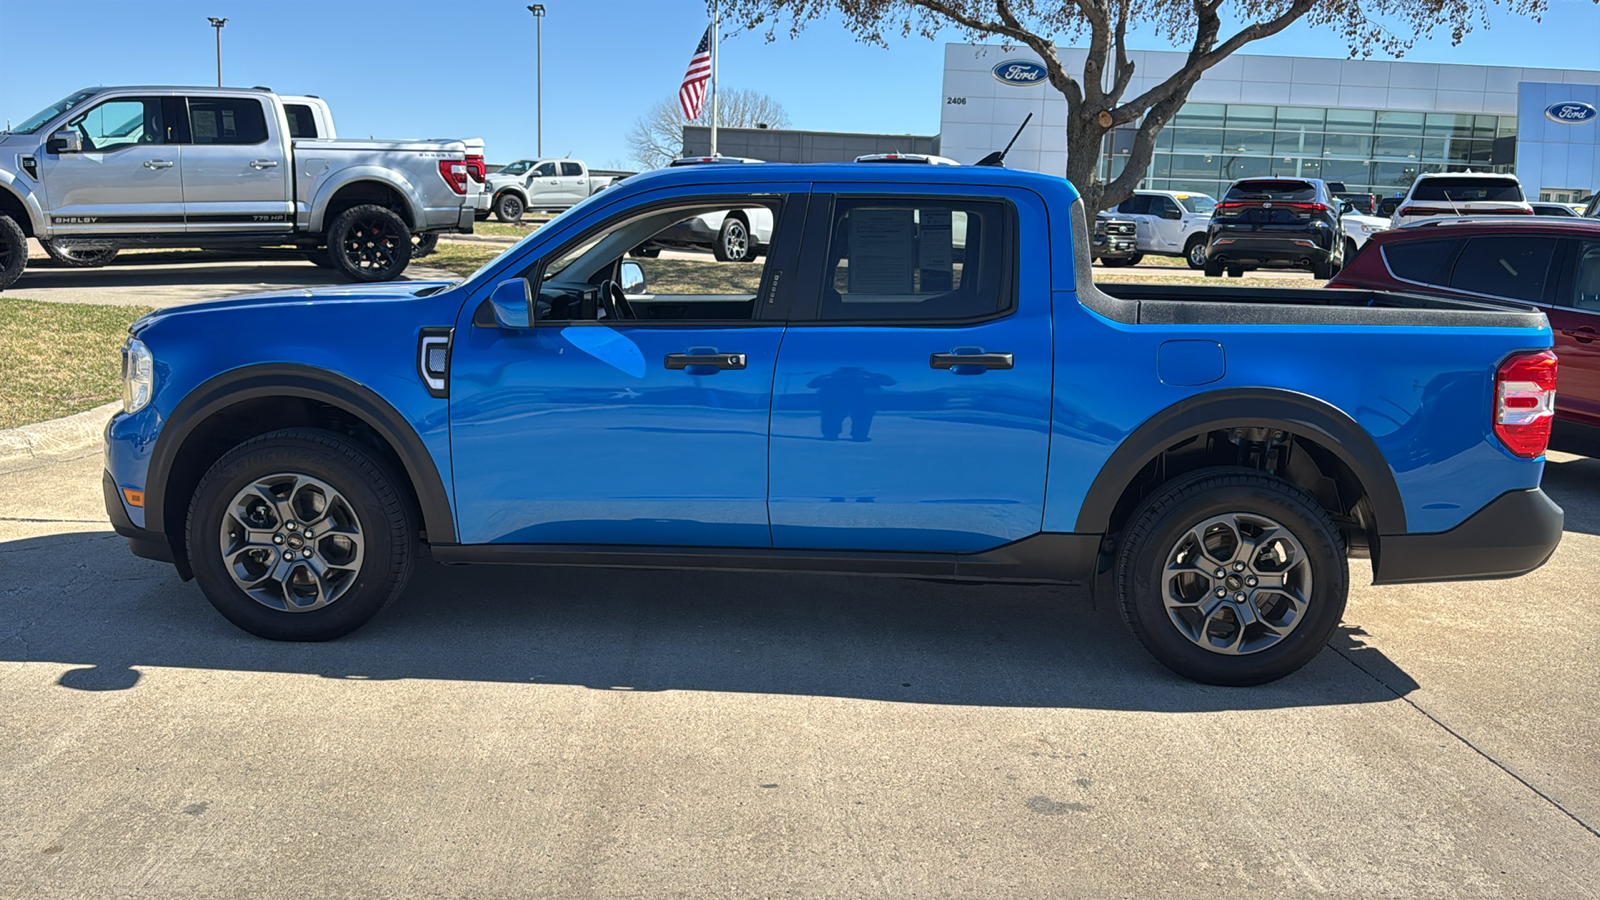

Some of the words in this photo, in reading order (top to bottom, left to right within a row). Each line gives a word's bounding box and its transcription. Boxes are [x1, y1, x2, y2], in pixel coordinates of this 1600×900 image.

[1004, 64, 1039, 81] Ford
[946, 97, 967, 105] 2406
[1558, 105, 1588, 119] Ford
